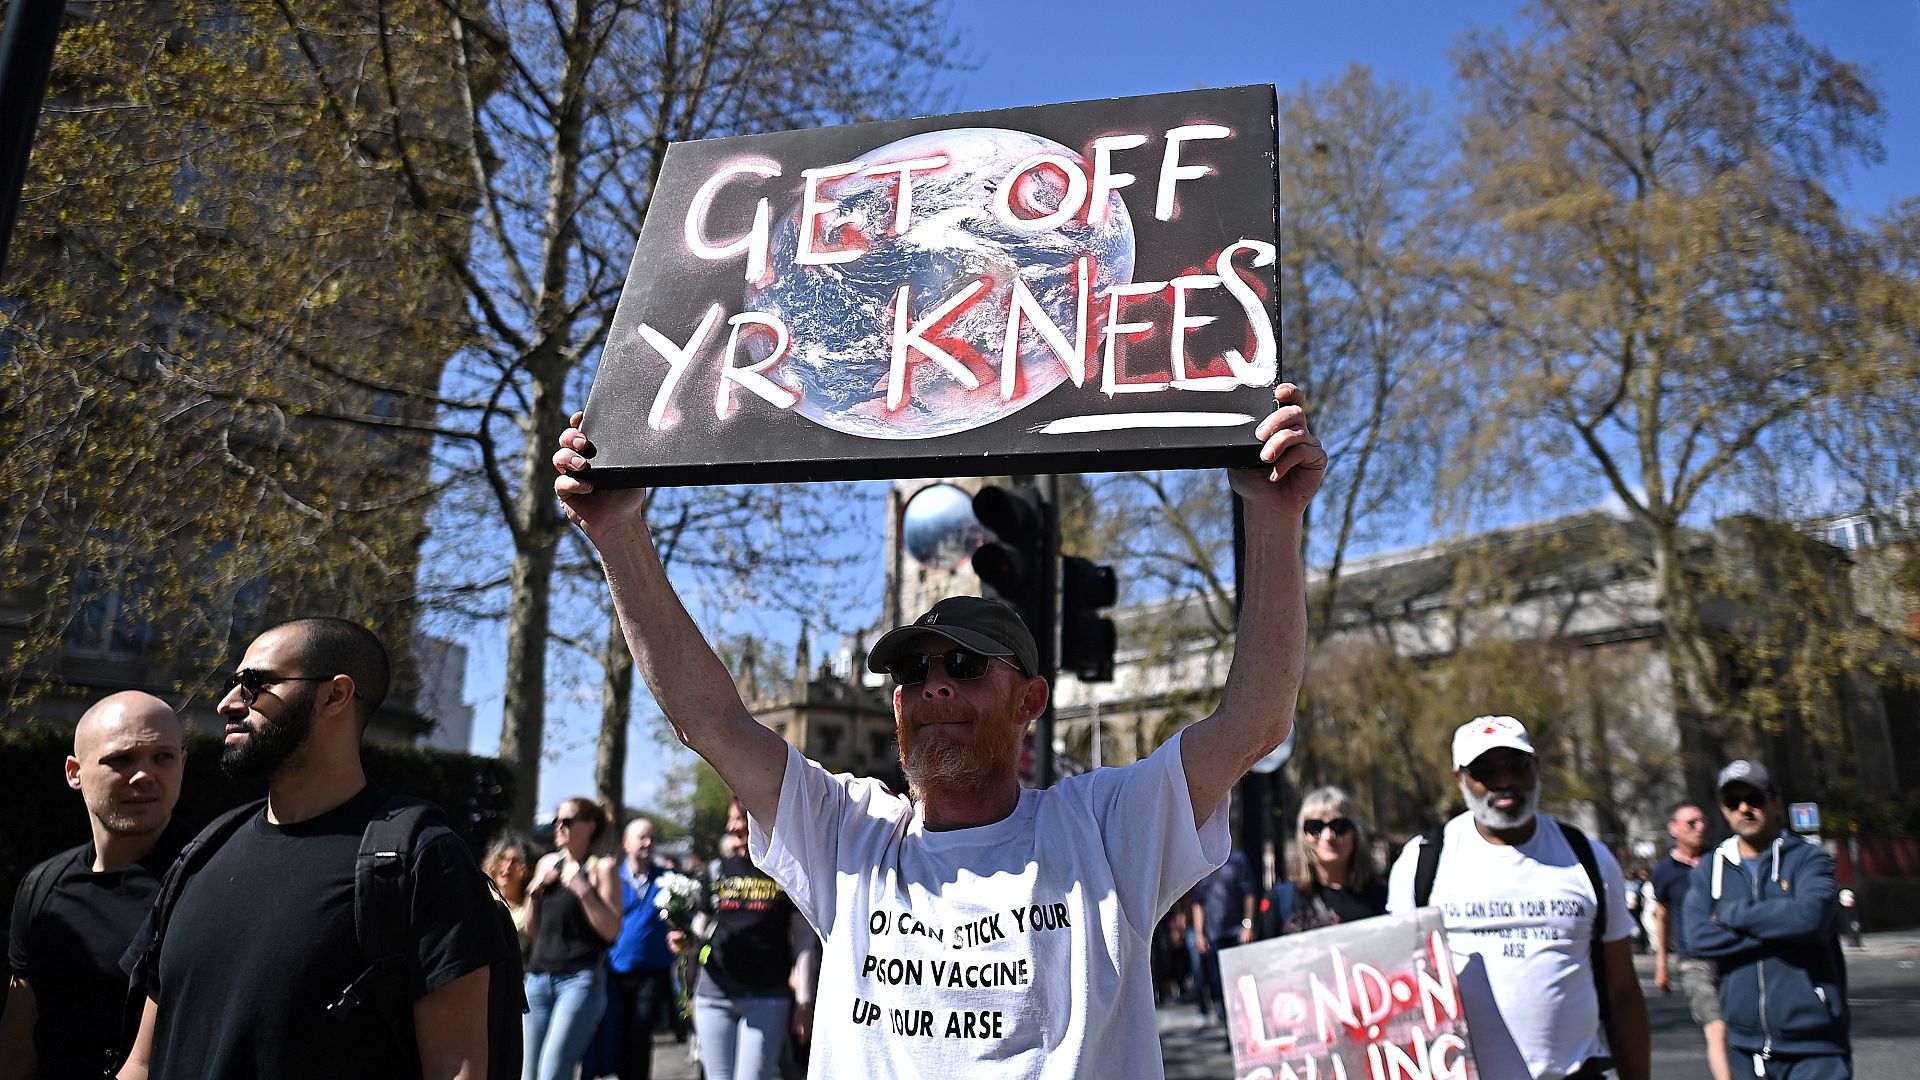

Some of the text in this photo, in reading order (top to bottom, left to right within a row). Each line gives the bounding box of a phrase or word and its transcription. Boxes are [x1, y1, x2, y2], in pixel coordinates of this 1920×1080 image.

[684, 124, 1231, 285] GET OFF
[637, 237, 1277, 431] YR KNEES
[897, 912, 943, 943] CAN
[952, 912, 1006, 950] STICK
[1011, 902, 1072, 932] YOUR
[861, 954, 1028, 989] PSON VACCINE
[852, 997, 882, 1027] UP
[944, 1010, 1003, 1040] ARSE
